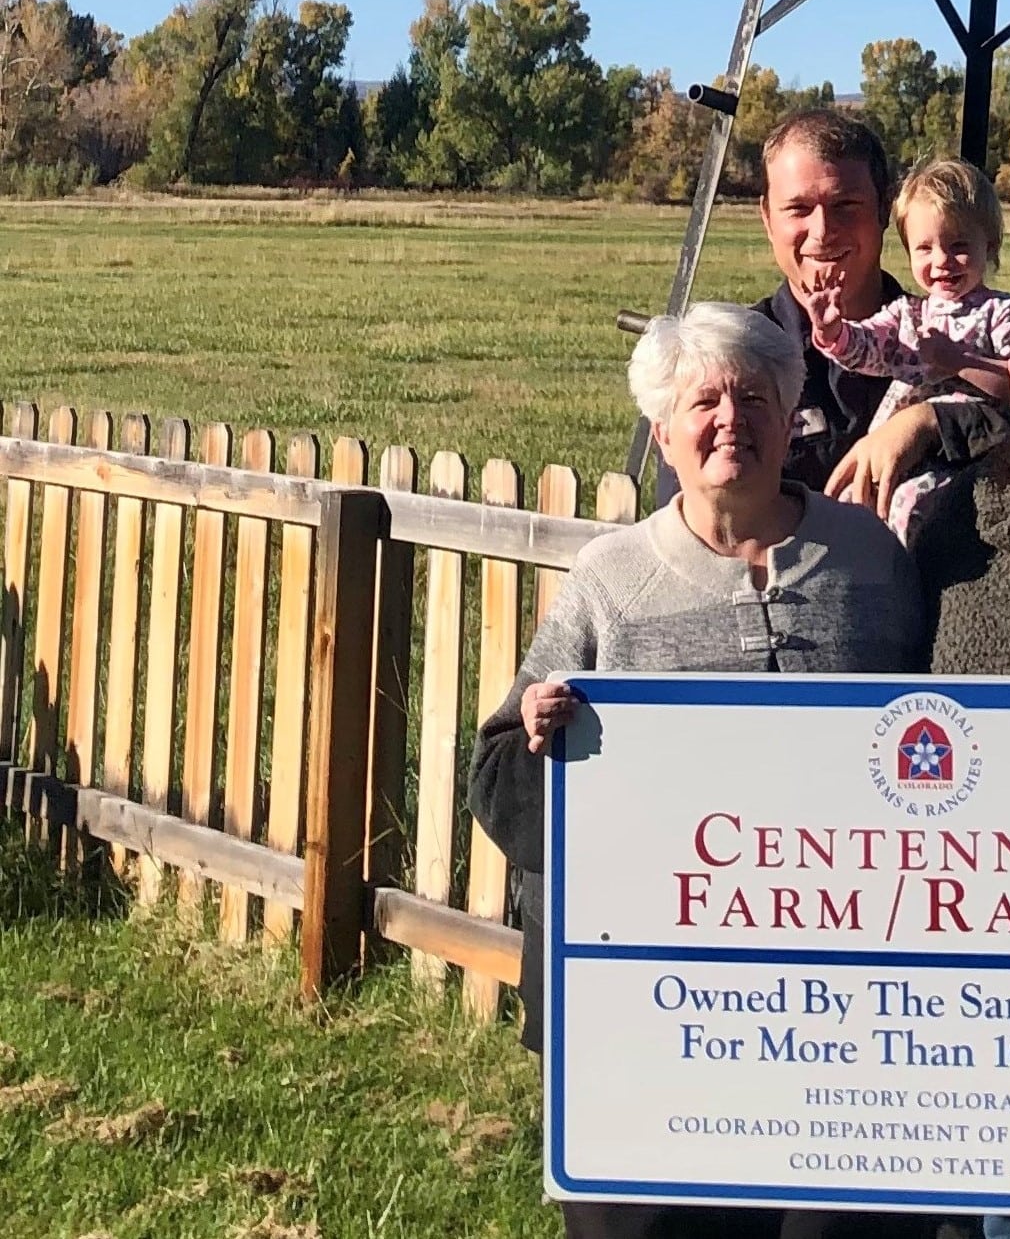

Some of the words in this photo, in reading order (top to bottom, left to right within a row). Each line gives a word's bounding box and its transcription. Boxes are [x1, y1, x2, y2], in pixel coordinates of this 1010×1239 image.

[874, 698, 973, 737] CENTENNIAL
[869, 757, 904, 808] FARMS
[907, 803, 918, 816] &
[926, 758, 982, 816] RANCHES
[654, 975, 787, 1013] Owned
[801, 979, 853, 1024] By
[868, 981, 944, 1017] The
[680, 1024, 744, 1060] For
[758, 1027, 857, 1063] More
[872, 1030, 974, 1067] Than
[806, 1088, 907, 1107] HISTORY
[669, 1117, 800, 1136] COLORADO
[811, 1121, 969, 1141] DEPARTMENT
[979, 1127, 1007, 1142] OF
[790, 1154, 922, 1172] COLORADO
[933, 1158, 1003, 1175] STATE
